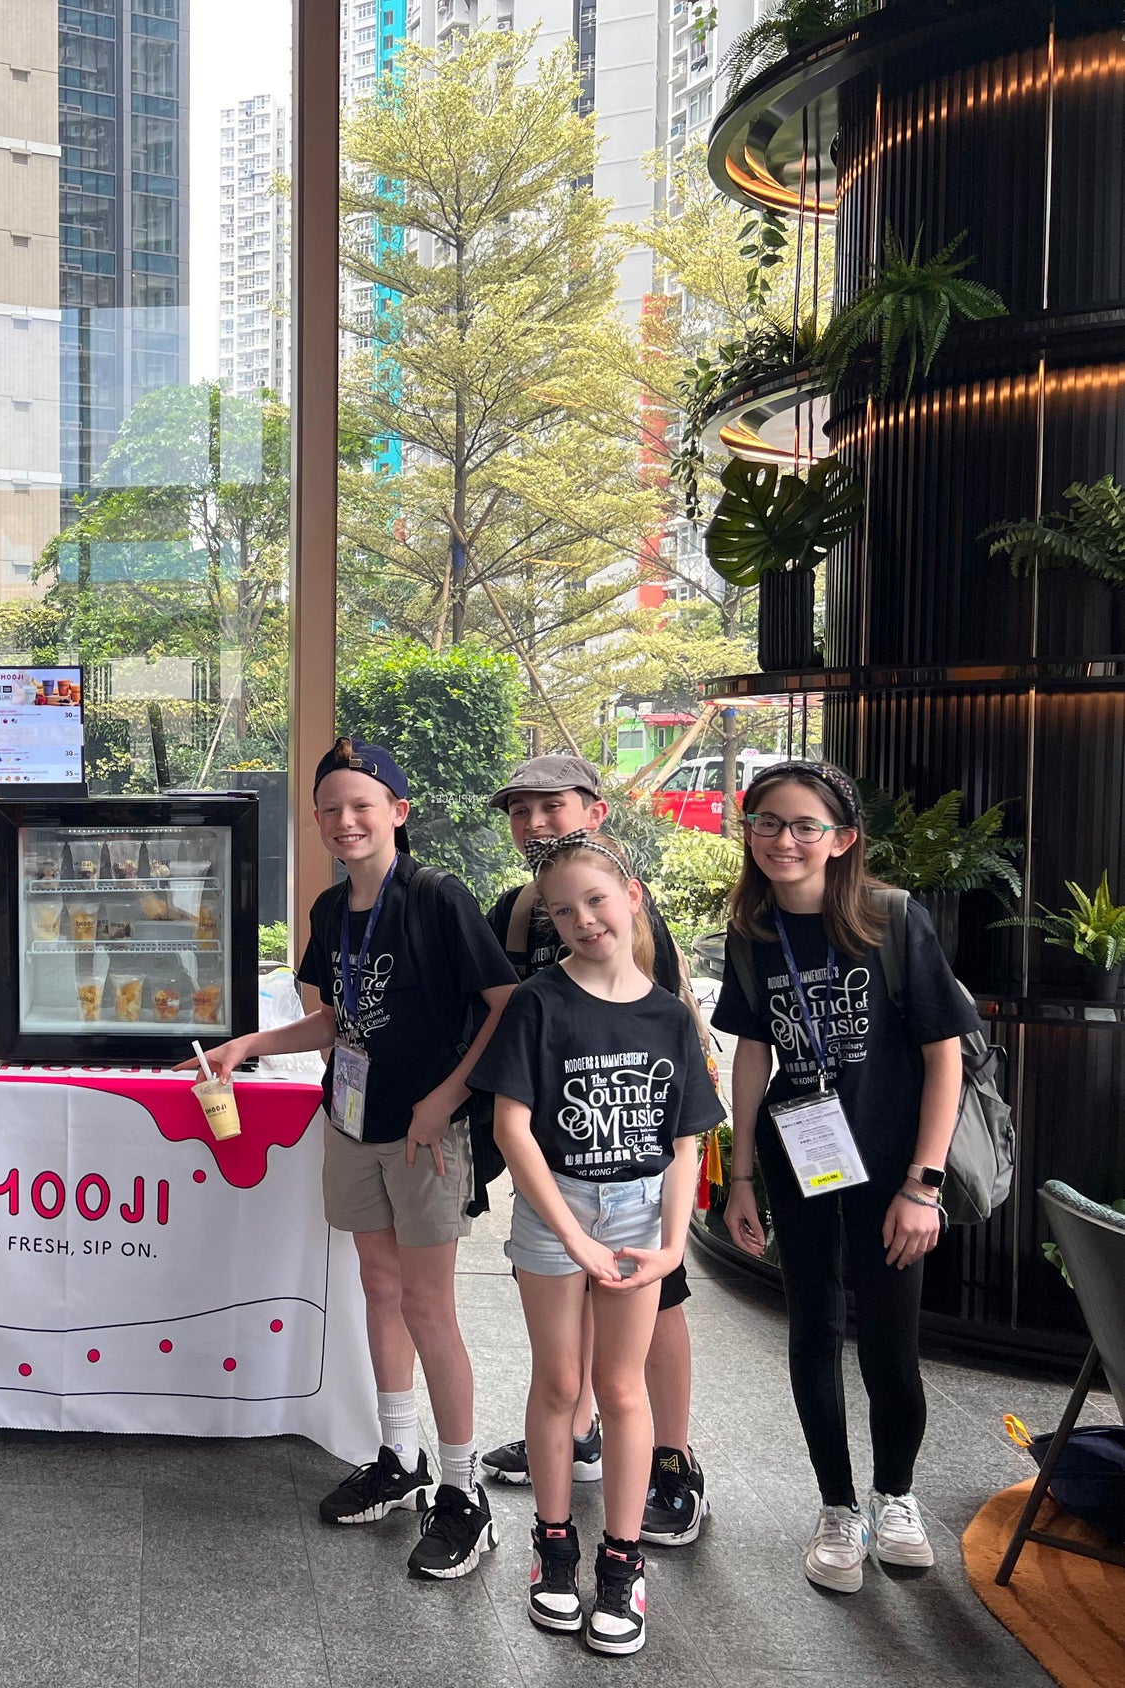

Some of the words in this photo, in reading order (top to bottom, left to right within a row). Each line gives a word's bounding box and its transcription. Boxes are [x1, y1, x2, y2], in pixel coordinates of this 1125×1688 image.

[375, 975, 391, 989] of
[855, 991, 869, 1010] of
[564, 1056, 594, 1073] RODGERS
[594, 1055, 600, 1069] &
[600, 1052, 649, 1069] HAMMERSTEIN'S
[590, 1073, 608, 1085] The
[653, 1082, 671, 1101] of
[589, 1103, 665, 1151] Music
[589, 1167, 612, 1177] KONG
[8, 1236, 75, 1258] FRESH,
[83, 1239, 113, 1256] SIP
[121, 1241, 158, 1259] ON.
